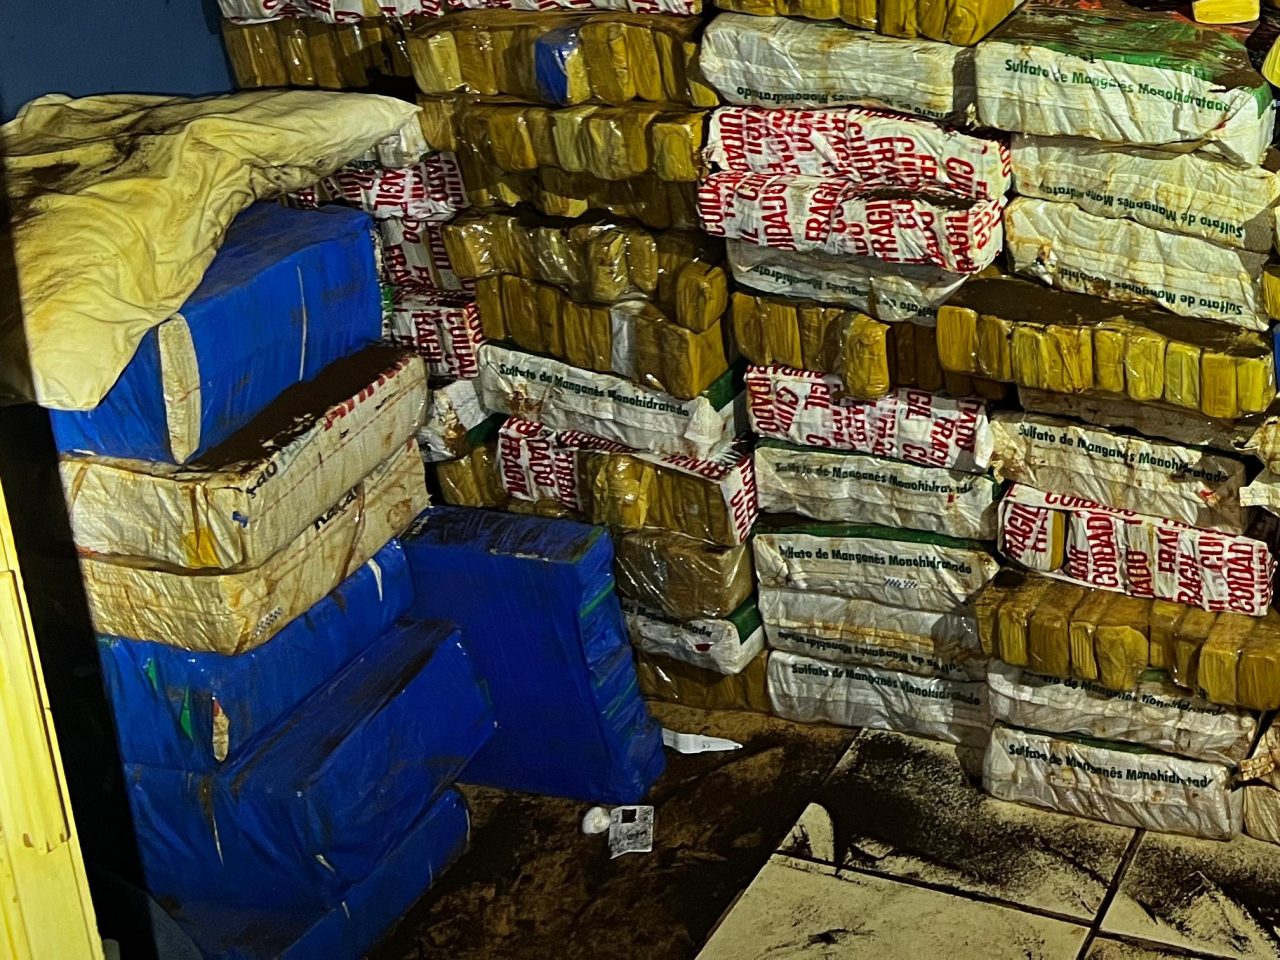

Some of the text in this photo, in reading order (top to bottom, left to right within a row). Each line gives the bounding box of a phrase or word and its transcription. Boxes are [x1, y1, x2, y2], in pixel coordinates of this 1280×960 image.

[1004, 59, 1049, 78] Sulfato
[1179, 211, 1196, 226] de
[1200, 217, 1244, 238] Sulfato
[1179, 293, 1196, 308] de
[1199, 298, 1244, 316] Sulfato
[499, 363, 537, 381] Sulfato
[539, 371, 553, 384] de
[1018, 423, 1056, 444] Sulfato
[1059, 433, 1074, 447] de
[815, 548, 829, 560] de
[831, 549, 886, 566] Manganês
[888, 555, 972, 574] Monohidratado
[1049, 753, 1064, 766] de
